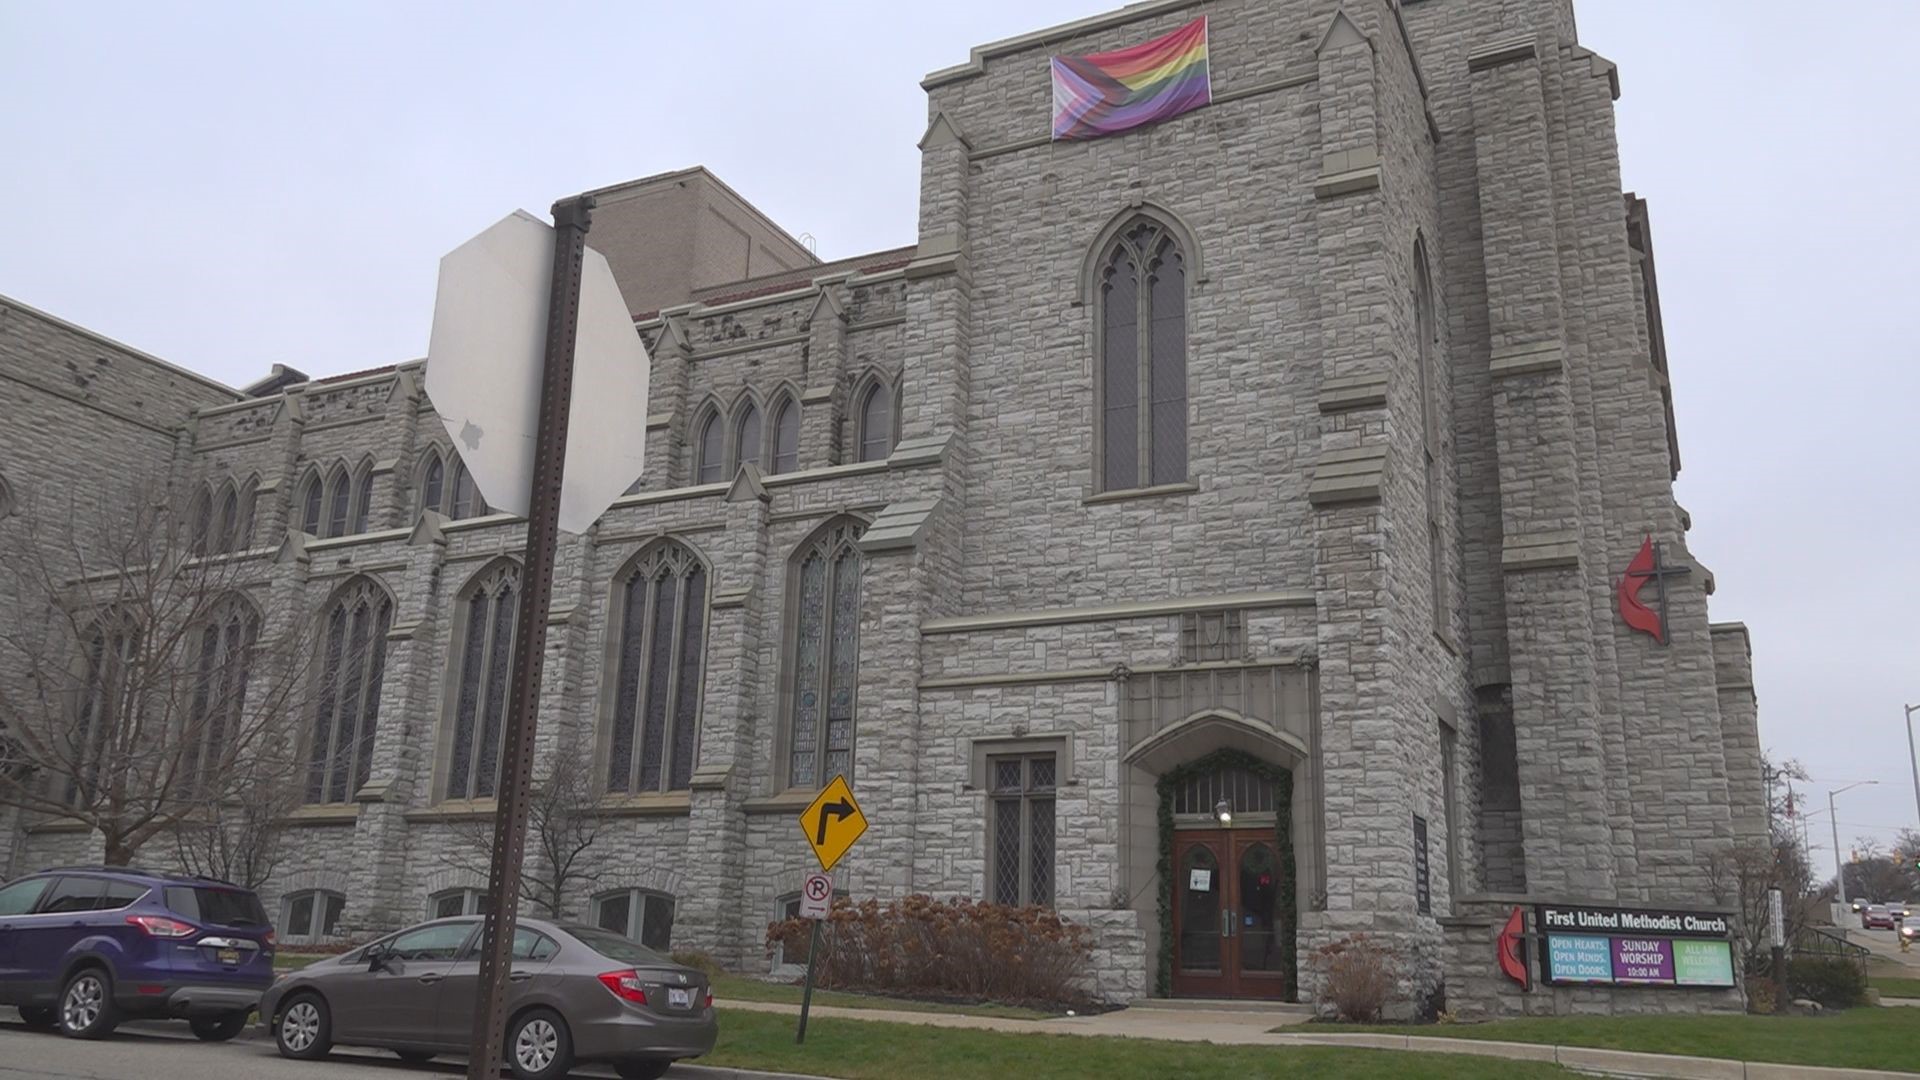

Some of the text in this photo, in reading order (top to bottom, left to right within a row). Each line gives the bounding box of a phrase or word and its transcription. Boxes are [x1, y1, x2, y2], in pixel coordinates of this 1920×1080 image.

[1545, 910, 1726, 932] First United Methodist Church
[1622, 940, 1660, 952] SUNDAY
[1620, 953, 1664, 964] WORSHIP
[1627, 967, 1660, 977] 10:00 AM
